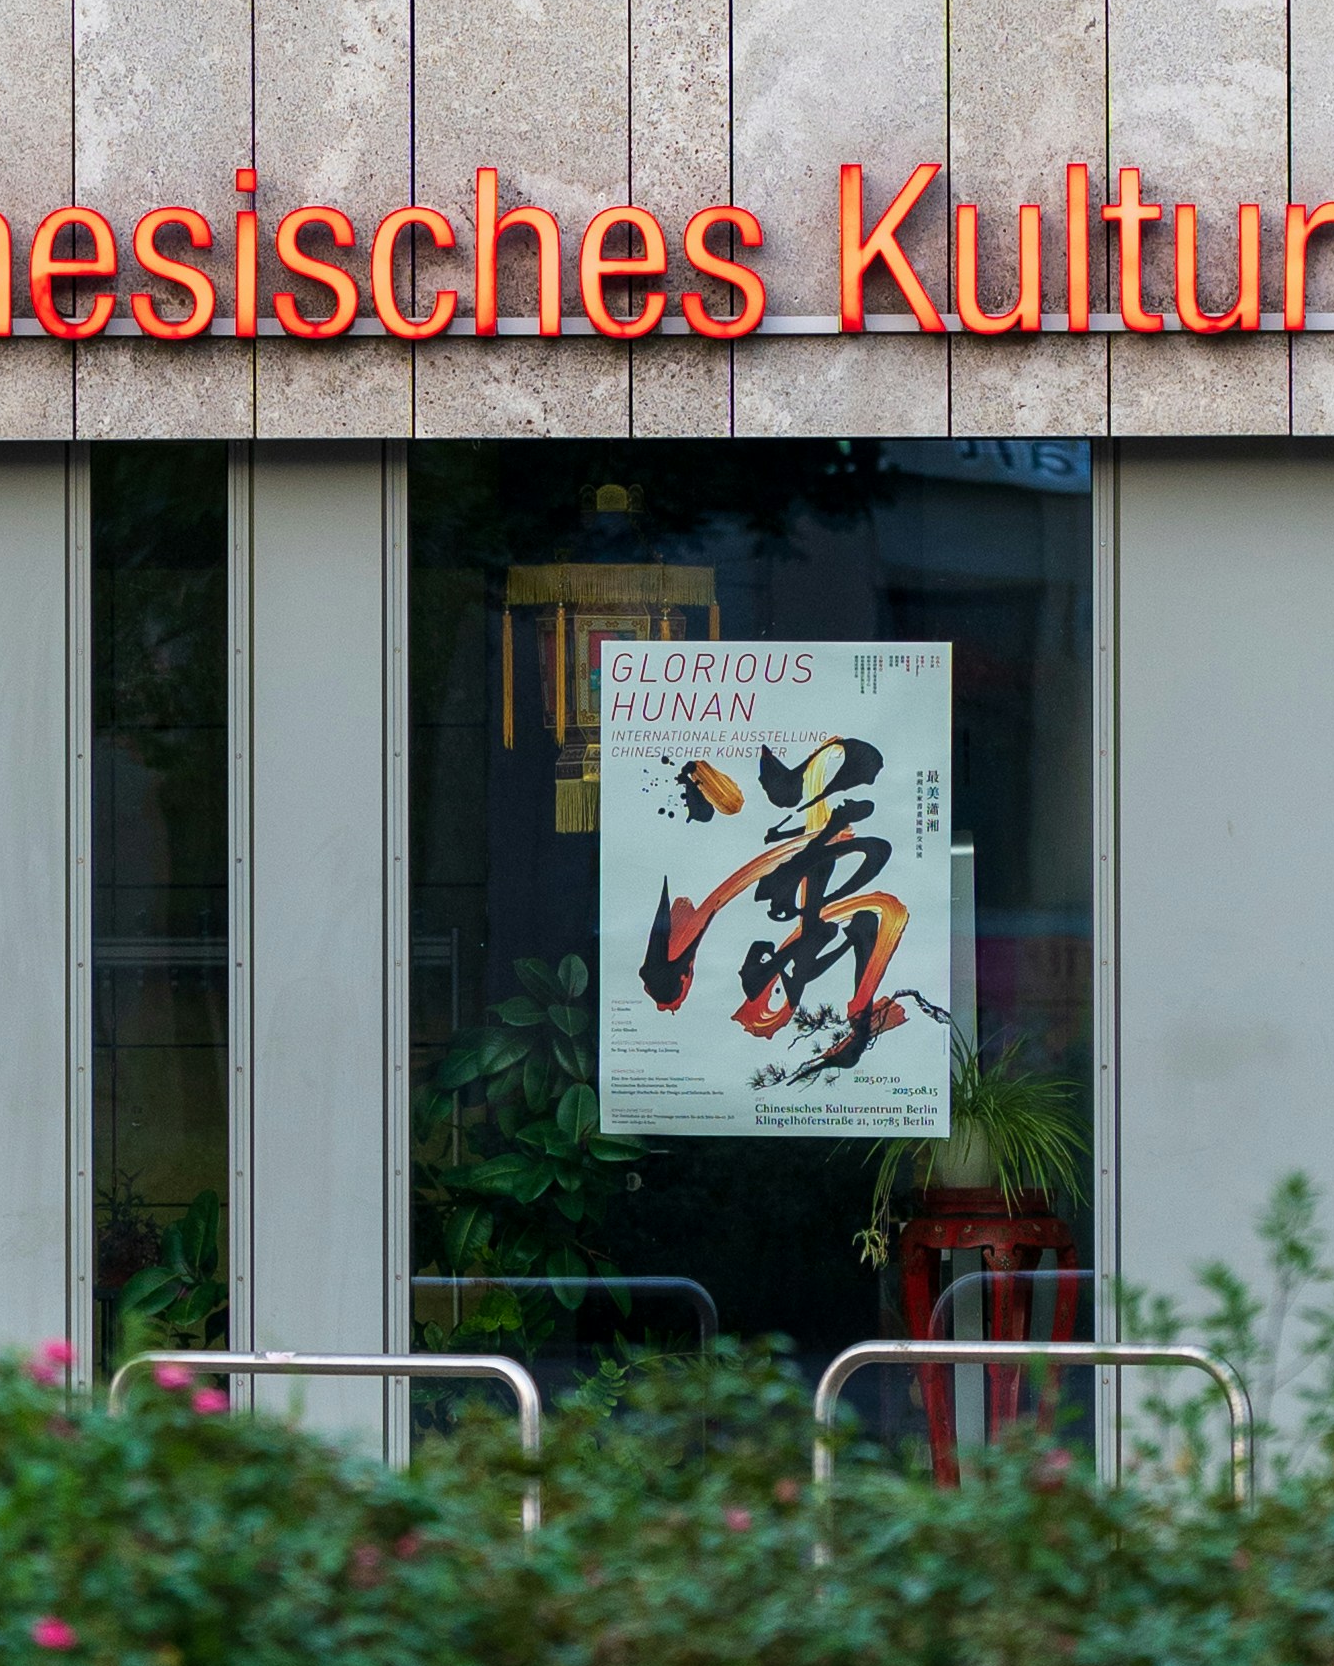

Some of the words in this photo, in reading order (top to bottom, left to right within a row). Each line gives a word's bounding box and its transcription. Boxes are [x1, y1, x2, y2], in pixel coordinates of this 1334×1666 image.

[611, 653, 814, 683] GLORIOUS
[611, 692, 755, 721] HUNAN
[611, 730, 727, 742] INTERNATIONALE
[731, 730, 828, 742] AUSSTELLUNG
[611, 746, 712, 758] CHINESISCHER
[716, 744, 787, 758] KÜNSTER
[854, 1076, 901, 1085] 2025.07.10
[755, 1104, 823, 1114] Chinesisches
[825, 1104, 902, 1114] Kulturzentrum
[907, 1104, 938, 1114] Berlin
[755, 1115, 854, 1128] Klingelhöferstraße
[856, 1119, 870, 1127] 21,
[872, 1117, 900, 1128] 10785
[903, 1116, 935, 1126] Berlin
